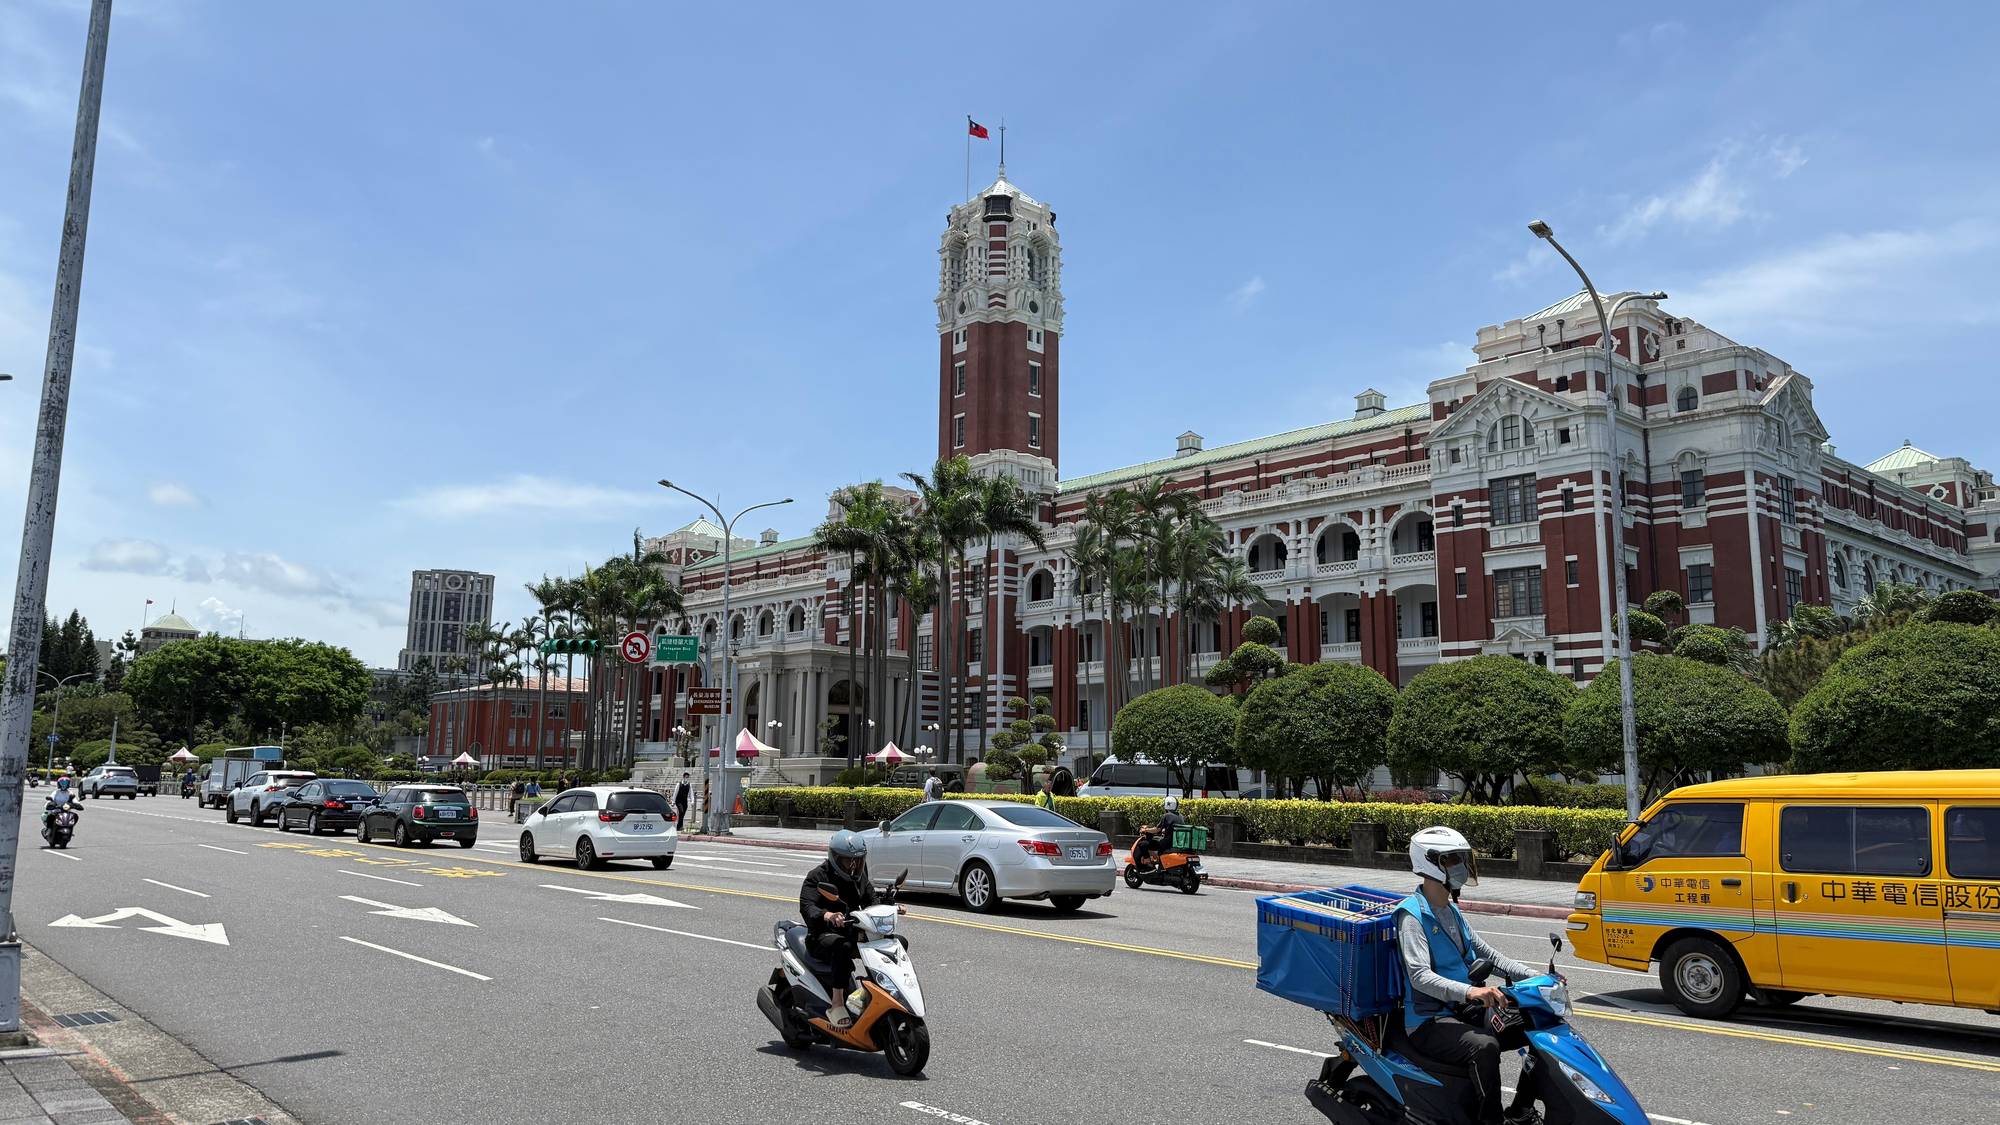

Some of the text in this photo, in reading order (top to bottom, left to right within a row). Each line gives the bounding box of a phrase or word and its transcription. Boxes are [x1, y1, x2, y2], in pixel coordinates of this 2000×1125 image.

[1661, 878, 1710, 889] 中華電信
[1674, 893, 1711, 904] 工程車
[1821, 880, 2000, 909] 中華電信股份
